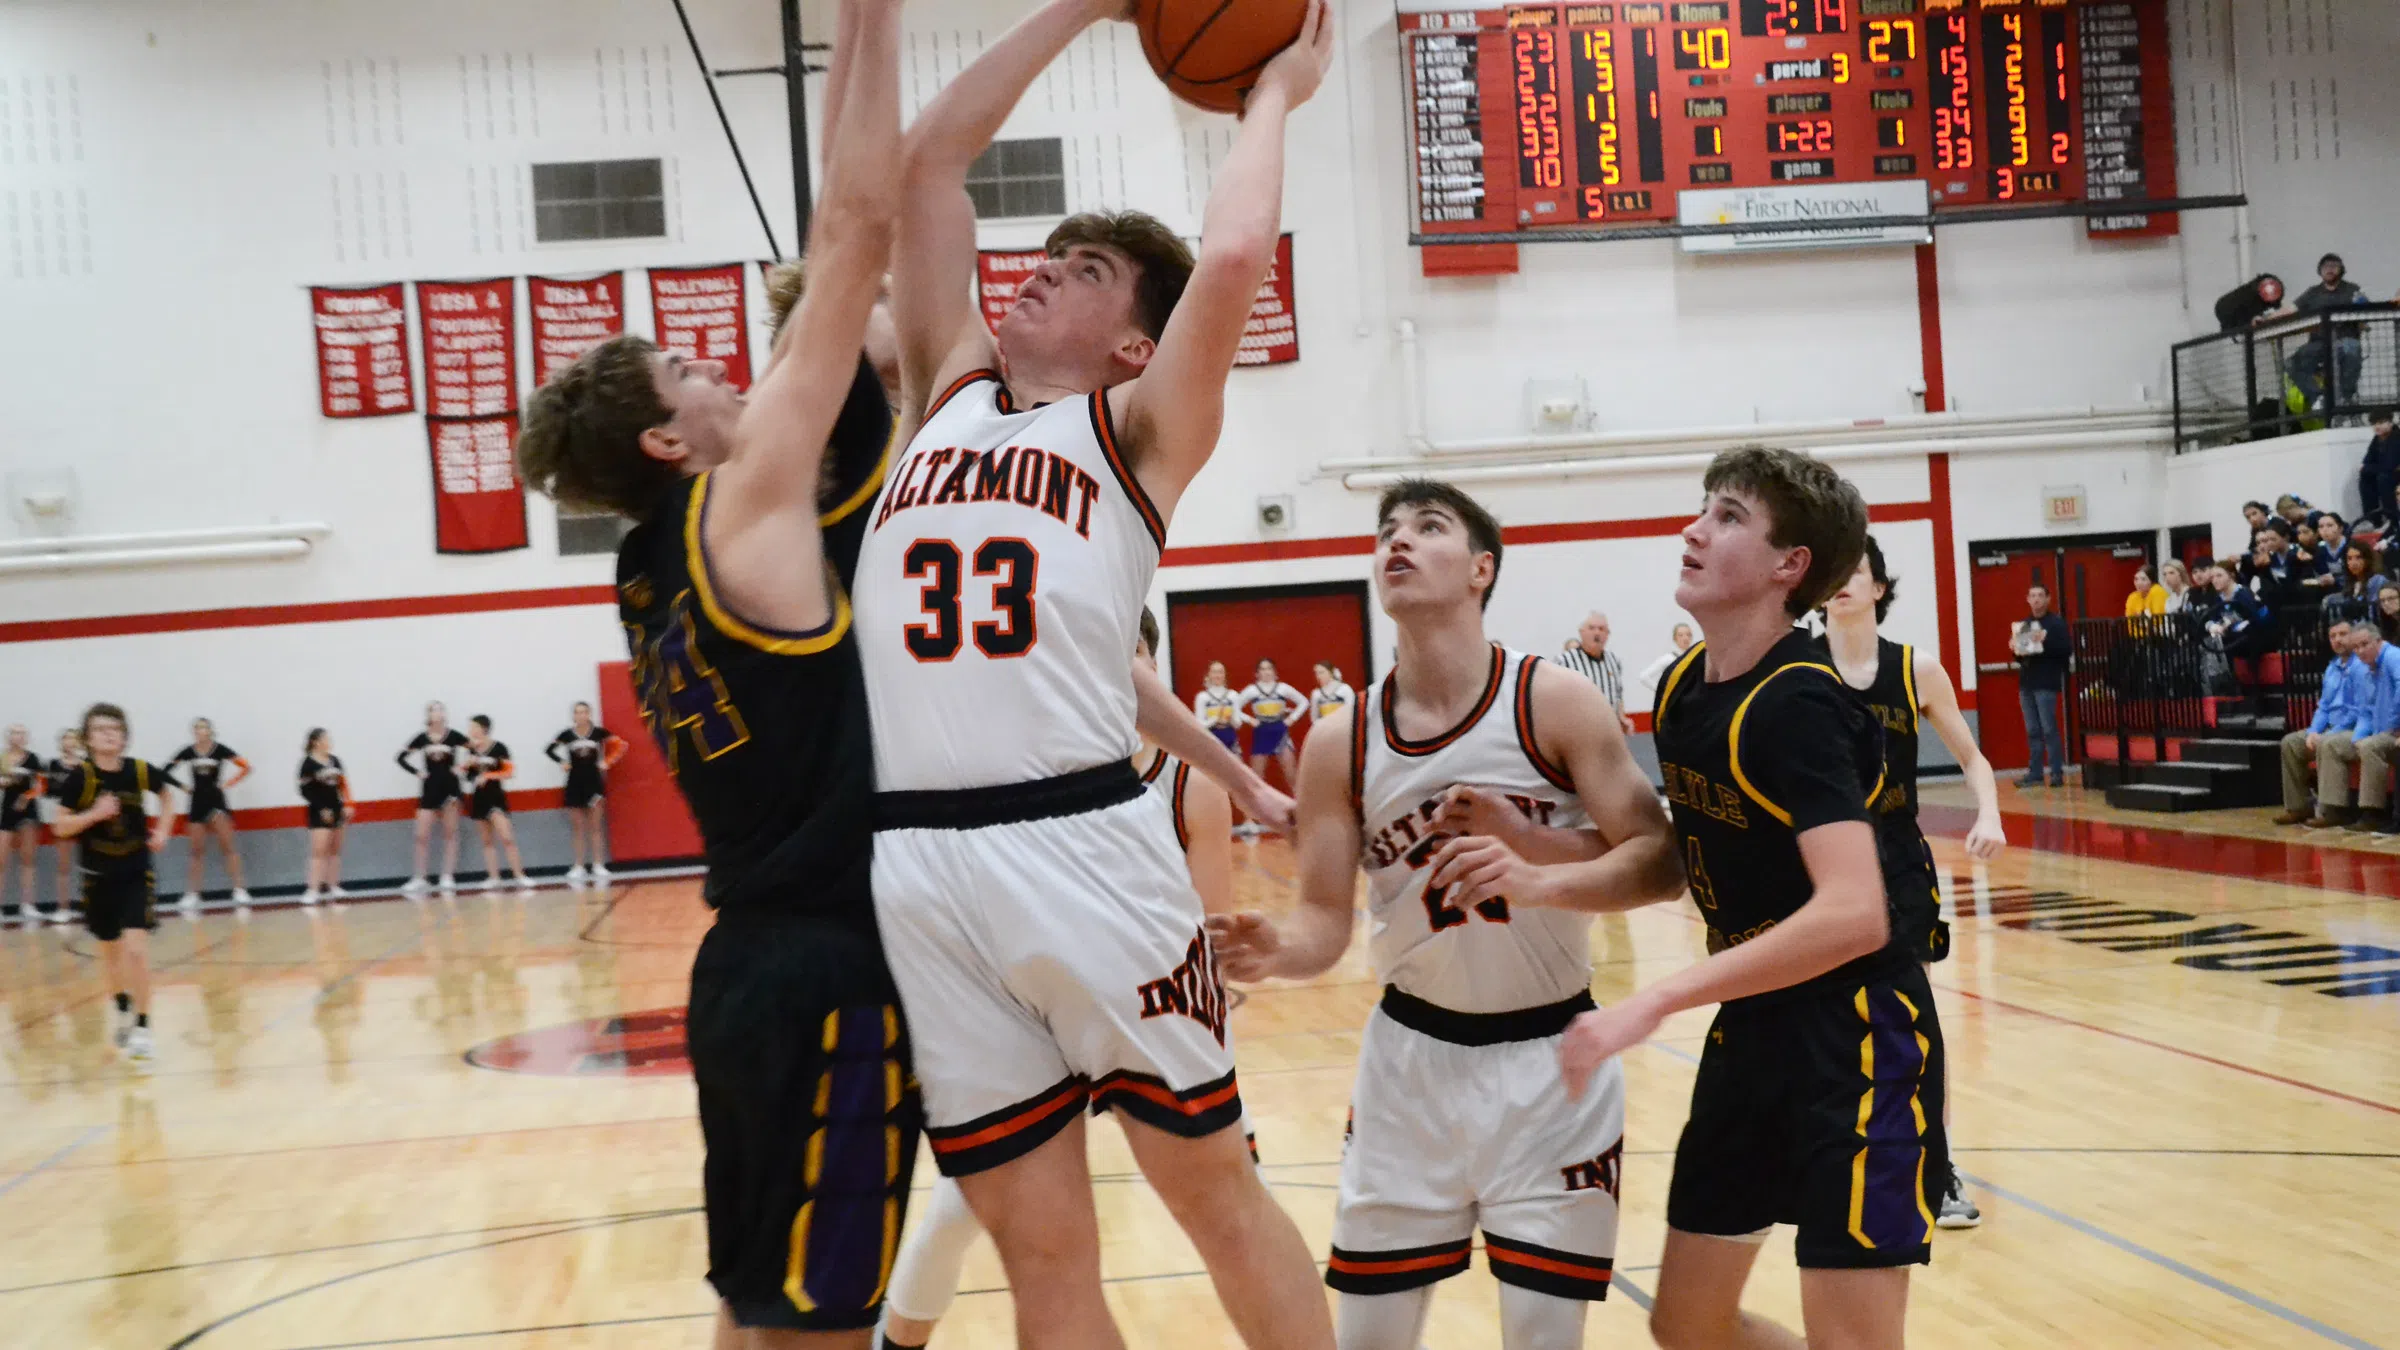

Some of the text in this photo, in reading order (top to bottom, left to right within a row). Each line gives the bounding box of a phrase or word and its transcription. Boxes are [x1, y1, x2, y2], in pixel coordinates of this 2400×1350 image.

[1568, 6, 1611, 27] points
[1679, 4, 1721, 22] Home
[2003, 13, 2021, 42] 4
[1584, 29, 1611, 61] 12
[1646, 29, 1654, 57] 1
[1868, 20, 1916, 63] 27
[1948, 16, 1966, 43] 4
[1516, 31, 1554, 64] 23
[1681, 28, 1730, 69] 40
[1940, 45, 1967, 76] 15
[2006, 43, 2022, 74] 2
[2056, 42, 2064, 70] 1
[1518, 63, 1556, 95] 21
[1596, 60, 1613, 92] 3
[1773, 52, 1850, 84] period 3
[1952, 76, 1969, 107] 2
[2007, 74, 2025, 105] 5
[2058, 73, 2065, 101] 1
[1520, 93, 1557, 125] 22
[1650, 91, 1658, 119] 1
[2008, 105, 2026, 136] 9
[1599, 122, 1617, 154] 2
[1896, 118, 1904, 146] 1
[1935, 107, 1971, 138] 34
[1522, 125, 1559, 157] 33
[1714, 127, 1722, 155] 1
[1936, 137, 1973, 169] 33
[2010, 135, 2029, 166] 3
[2051, 132, 2069, 164] 2
[1534, 156, 1562, 188] 10
[1600, 153, 1619, 185] 5
[1783, 161, 1821, 181] game
[1996, 168, 2014, 199] 3
[1585, 186, 1604, 219] 5
[1745, 200, 1789, 217] FIRST
[1794, 197, 1882, 216] NATIONAL
[874, 446, 1100, 541] ALTAMONT
[903, 536, 1039, 663] 33
